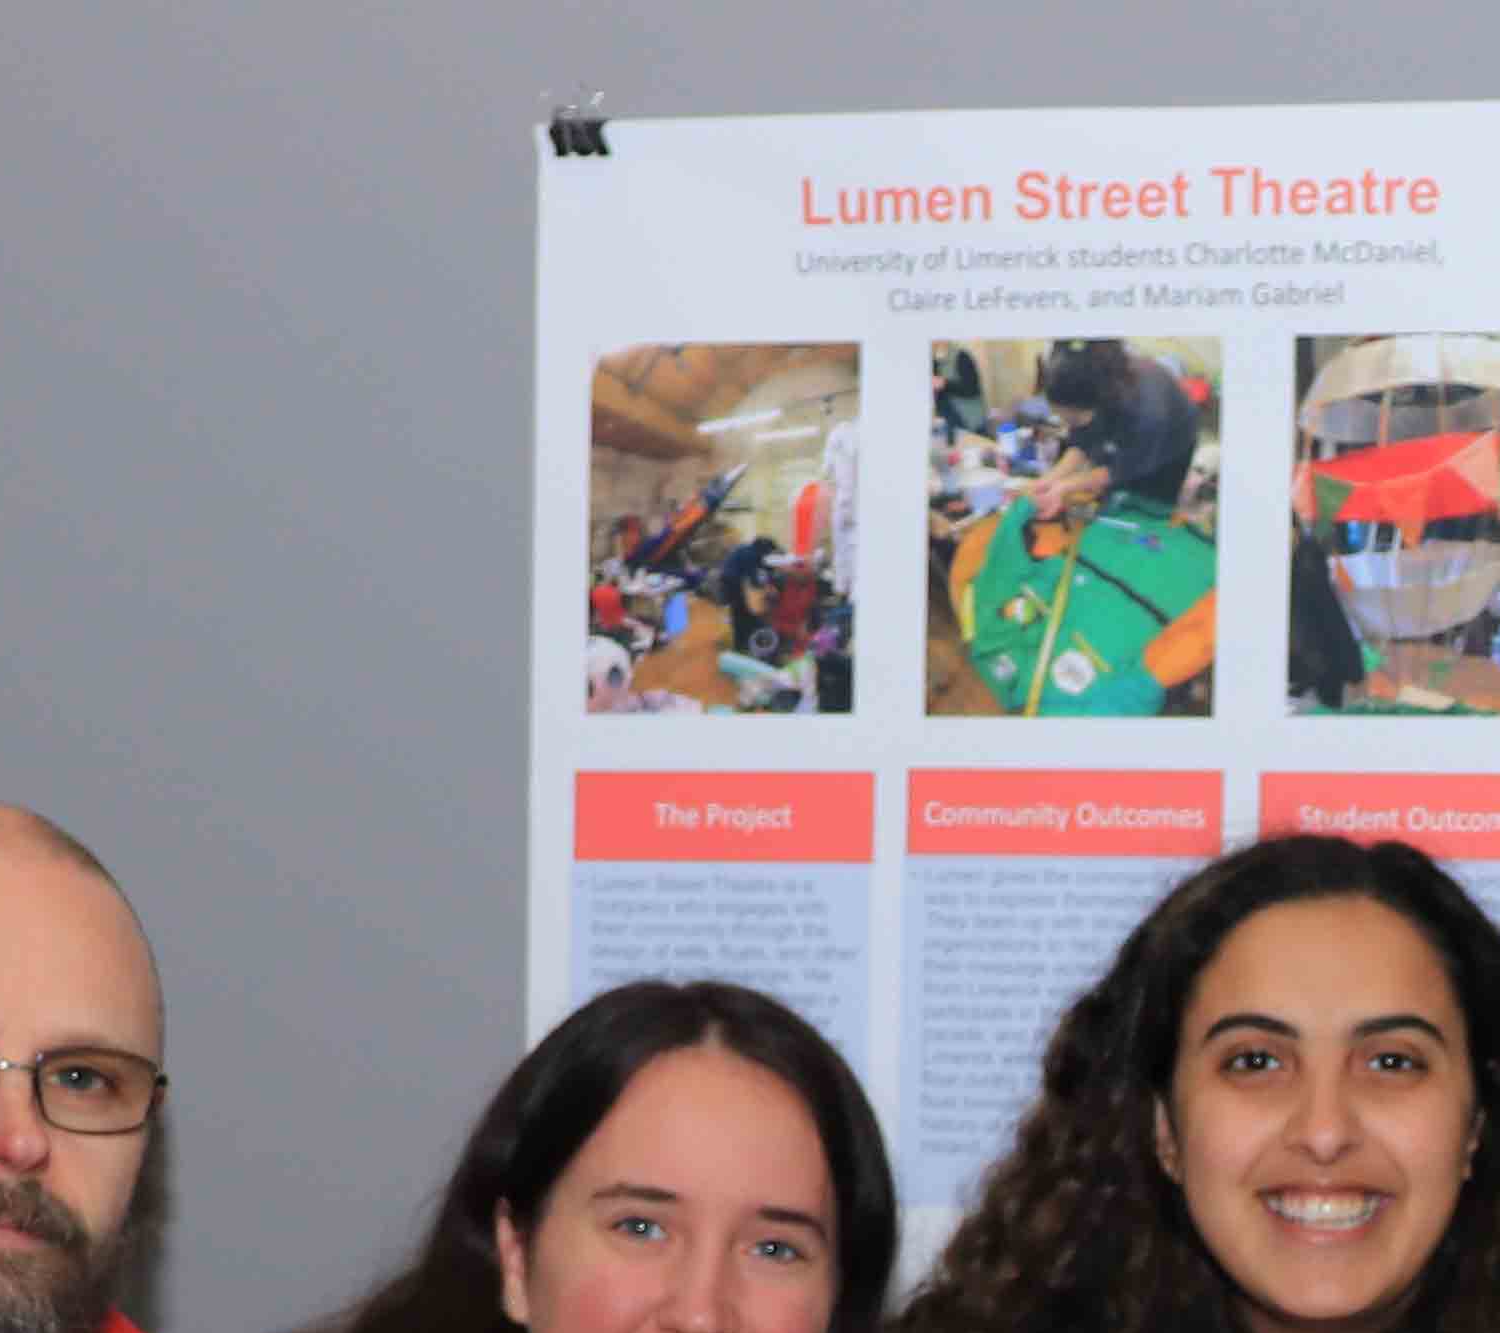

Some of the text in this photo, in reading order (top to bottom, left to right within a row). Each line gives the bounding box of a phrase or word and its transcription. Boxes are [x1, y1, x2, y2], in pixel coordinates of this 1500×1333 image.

[801, 168, 1443, 226] Lumen Street Theatre
[795, 240, 1444, 277] University of Limerick students Charlotte McDaniel,
[888, 279, 1344, 313] Claire LeFevers, and Mariam Gabriel
[653, 803, 792, 832] The Project
[924, 801, 1206, 830] Community Outcomes
[1298, 806, 1401, 833] Student
